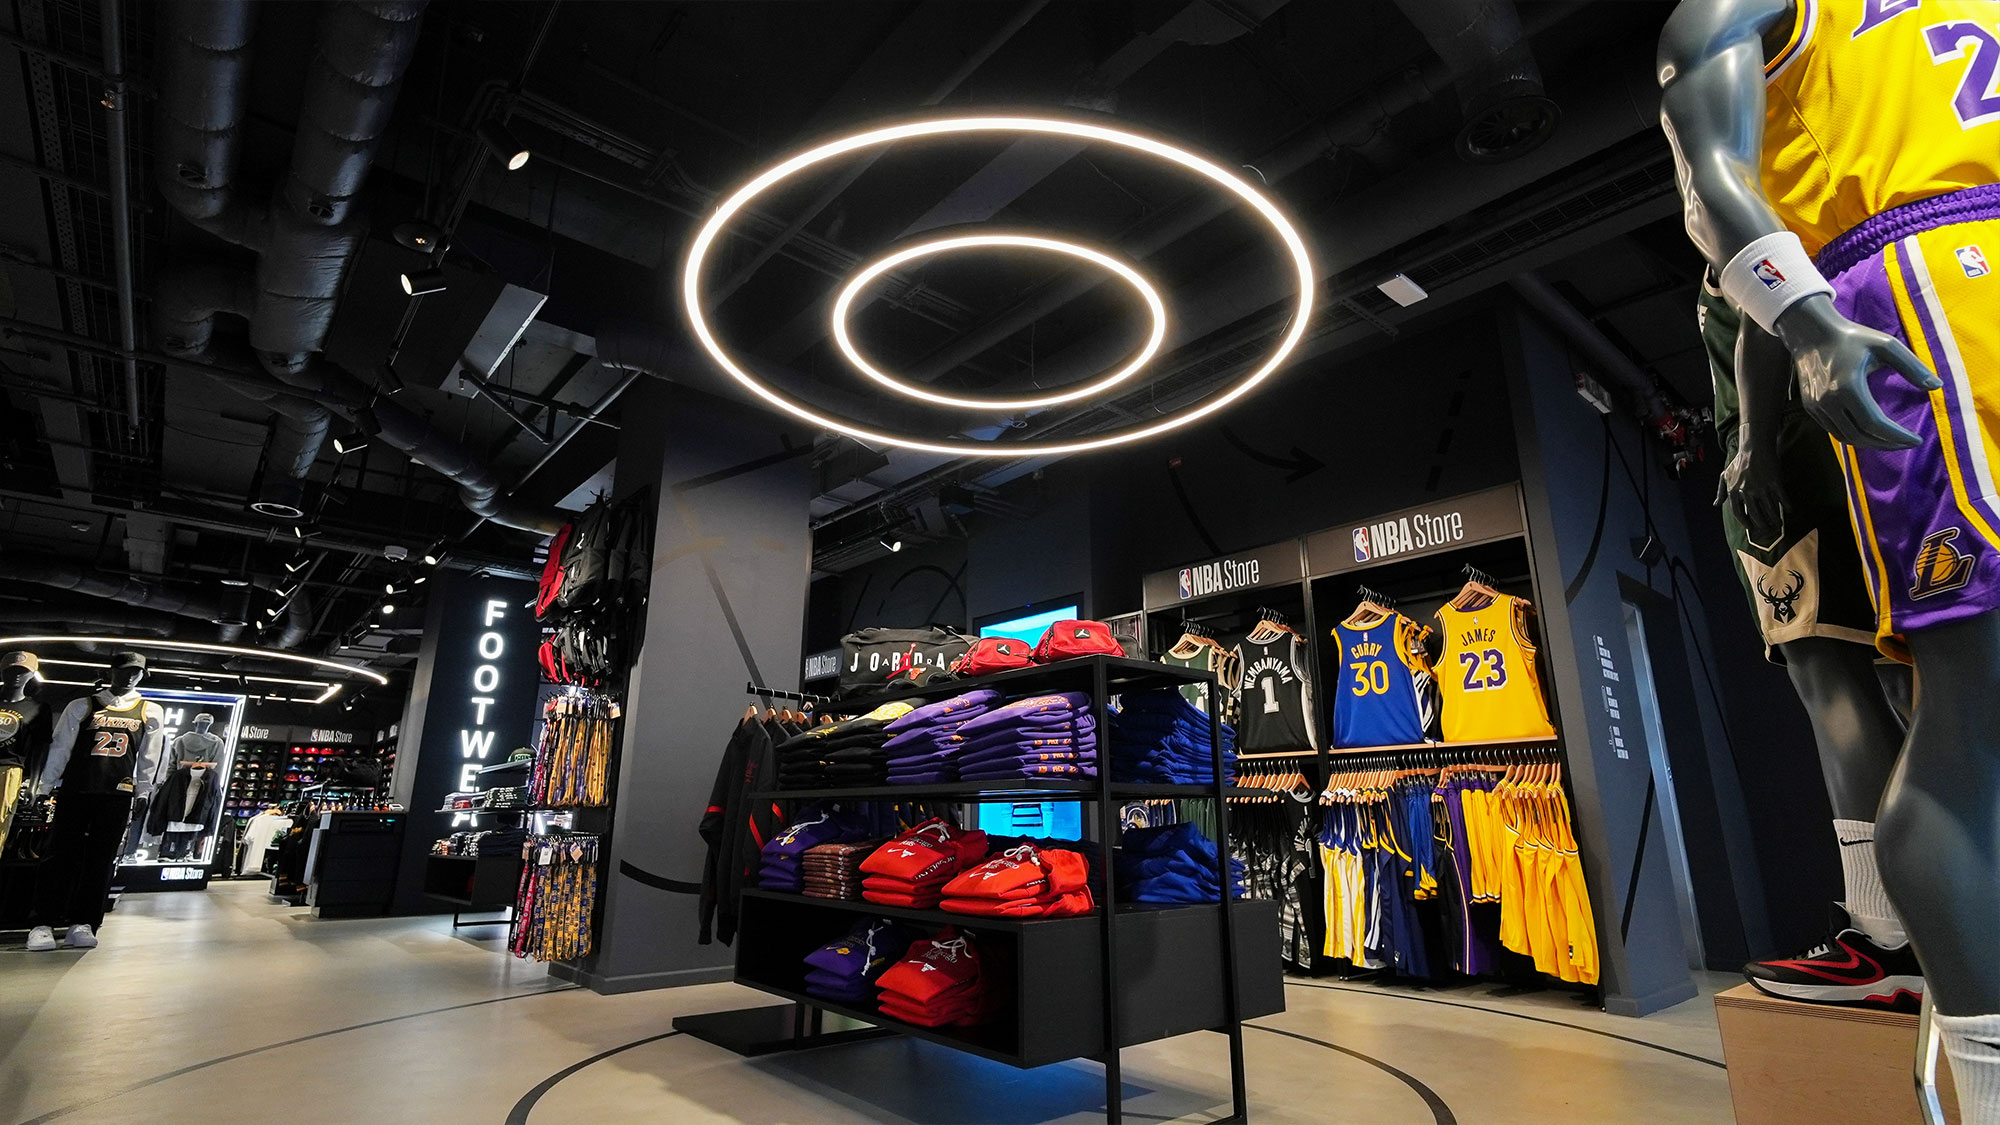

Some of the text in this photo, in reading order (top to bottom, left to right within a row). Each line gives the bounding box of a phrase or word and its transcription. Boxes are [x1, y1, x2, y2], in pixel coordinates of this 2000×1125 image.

[1370, 511, 1464, 558] NBA Store
[1191, 559, 1260, 596] NBA Store
[1350, 642, 1383, 659] CURRY
[1461, 628, 1496, 647] JAMES
[849, 652, 970, 672] JORDA
[1243, 657, 1293, 690] WEMBANYAMA
[1349, 660, 1390, 697] 30
[1459, 648, 1507, 692] 23
[1260, 676, 1280, 714] 1
[451, 599, 508, 828] FOOTWEA
[91, 731, 129, 758] 23
[249, 726, 269, 739] Store
[318, 730, 352, 743] NBA Store
